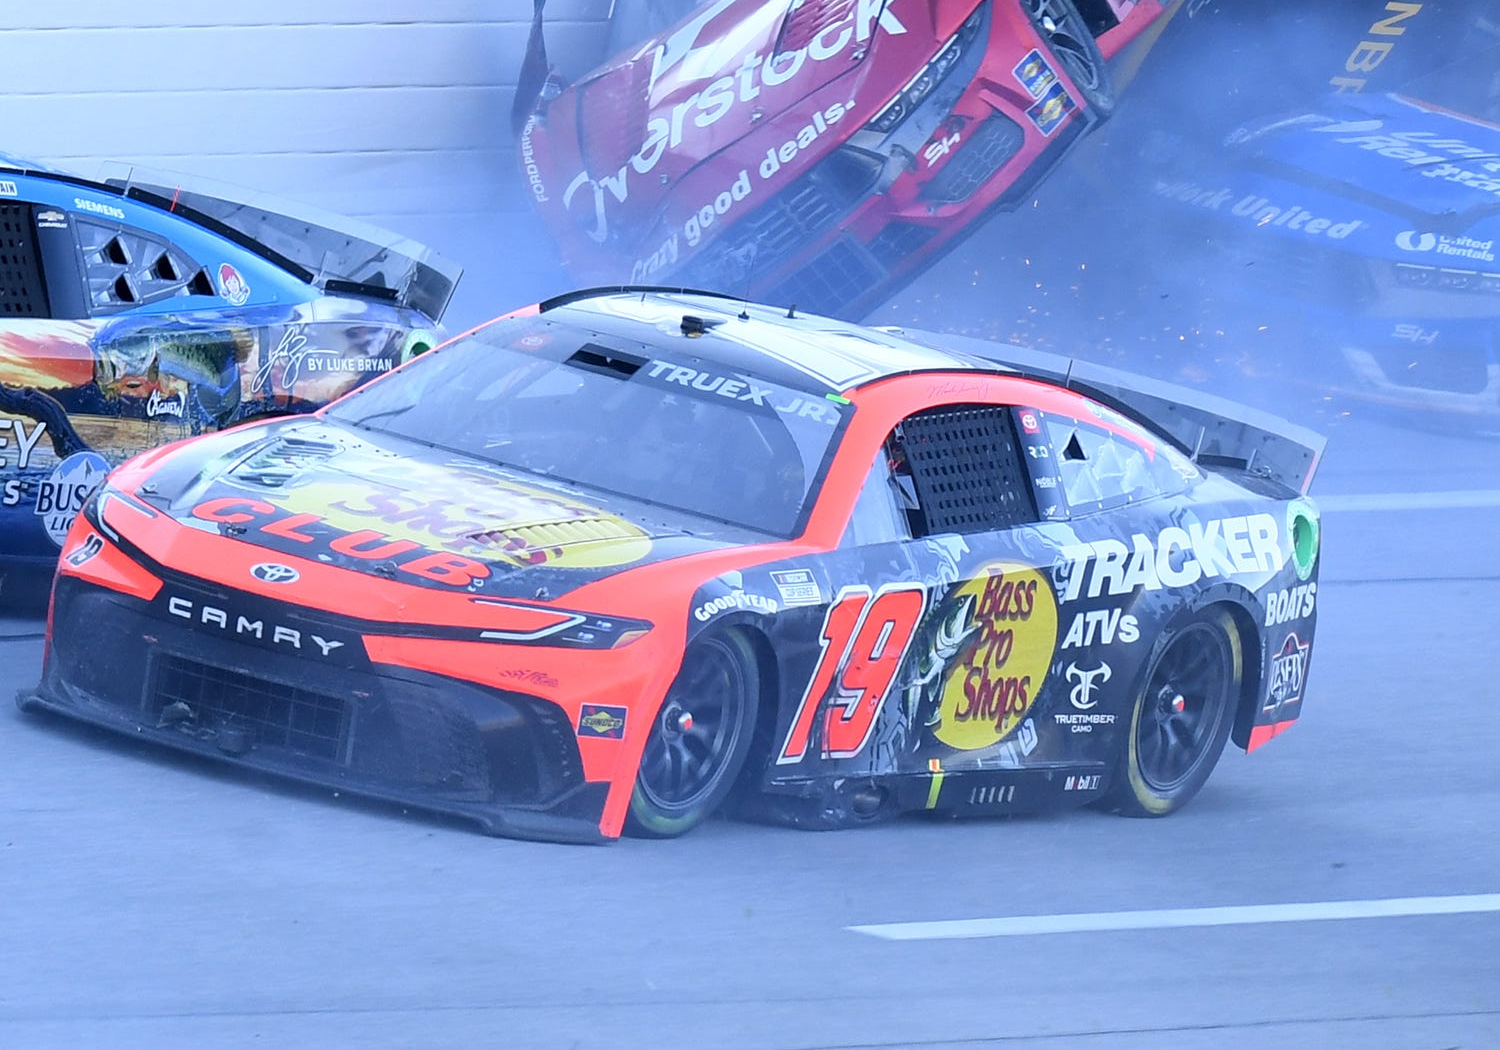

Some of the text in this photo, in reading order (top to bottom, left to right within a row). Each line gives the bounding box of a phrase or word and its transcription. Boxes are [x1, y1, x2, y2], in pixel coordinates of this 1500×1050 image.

[685, 169, 752, 247] good
[759, 100, 856, 179] deals.
[73, 198, 126, 220] SIEMENS
[1231, 195, 1363, 240] United
[1436, 243, 1496, 262] Rentals
[307, 358, 393, 371] BY LUKE BRYAN
[648, 360, 774, 407] TRUEX
[191, 497, 493, 588] CLUB
[1059, 513, 1283, 602] TRACKER
[694, 589, 778, 622] GOODYEAR
[975, 568, 1038, 622] Bass
[1265, 582, 1317, 627] BOATS
[168, 596, 345, 656] CAMRY
[964, 618, 1014, 671] Pro
[1061, 608, 1140, 649] ATVs
[776, 581, 927, 766] 19
[582, 716, 622, 728] SUNOCO
[954, 666, 1031, 734] Shops
[1054, 714, 1116, 725] TRUETIMBER
[1071, 724, 1093, 734] CAMO
